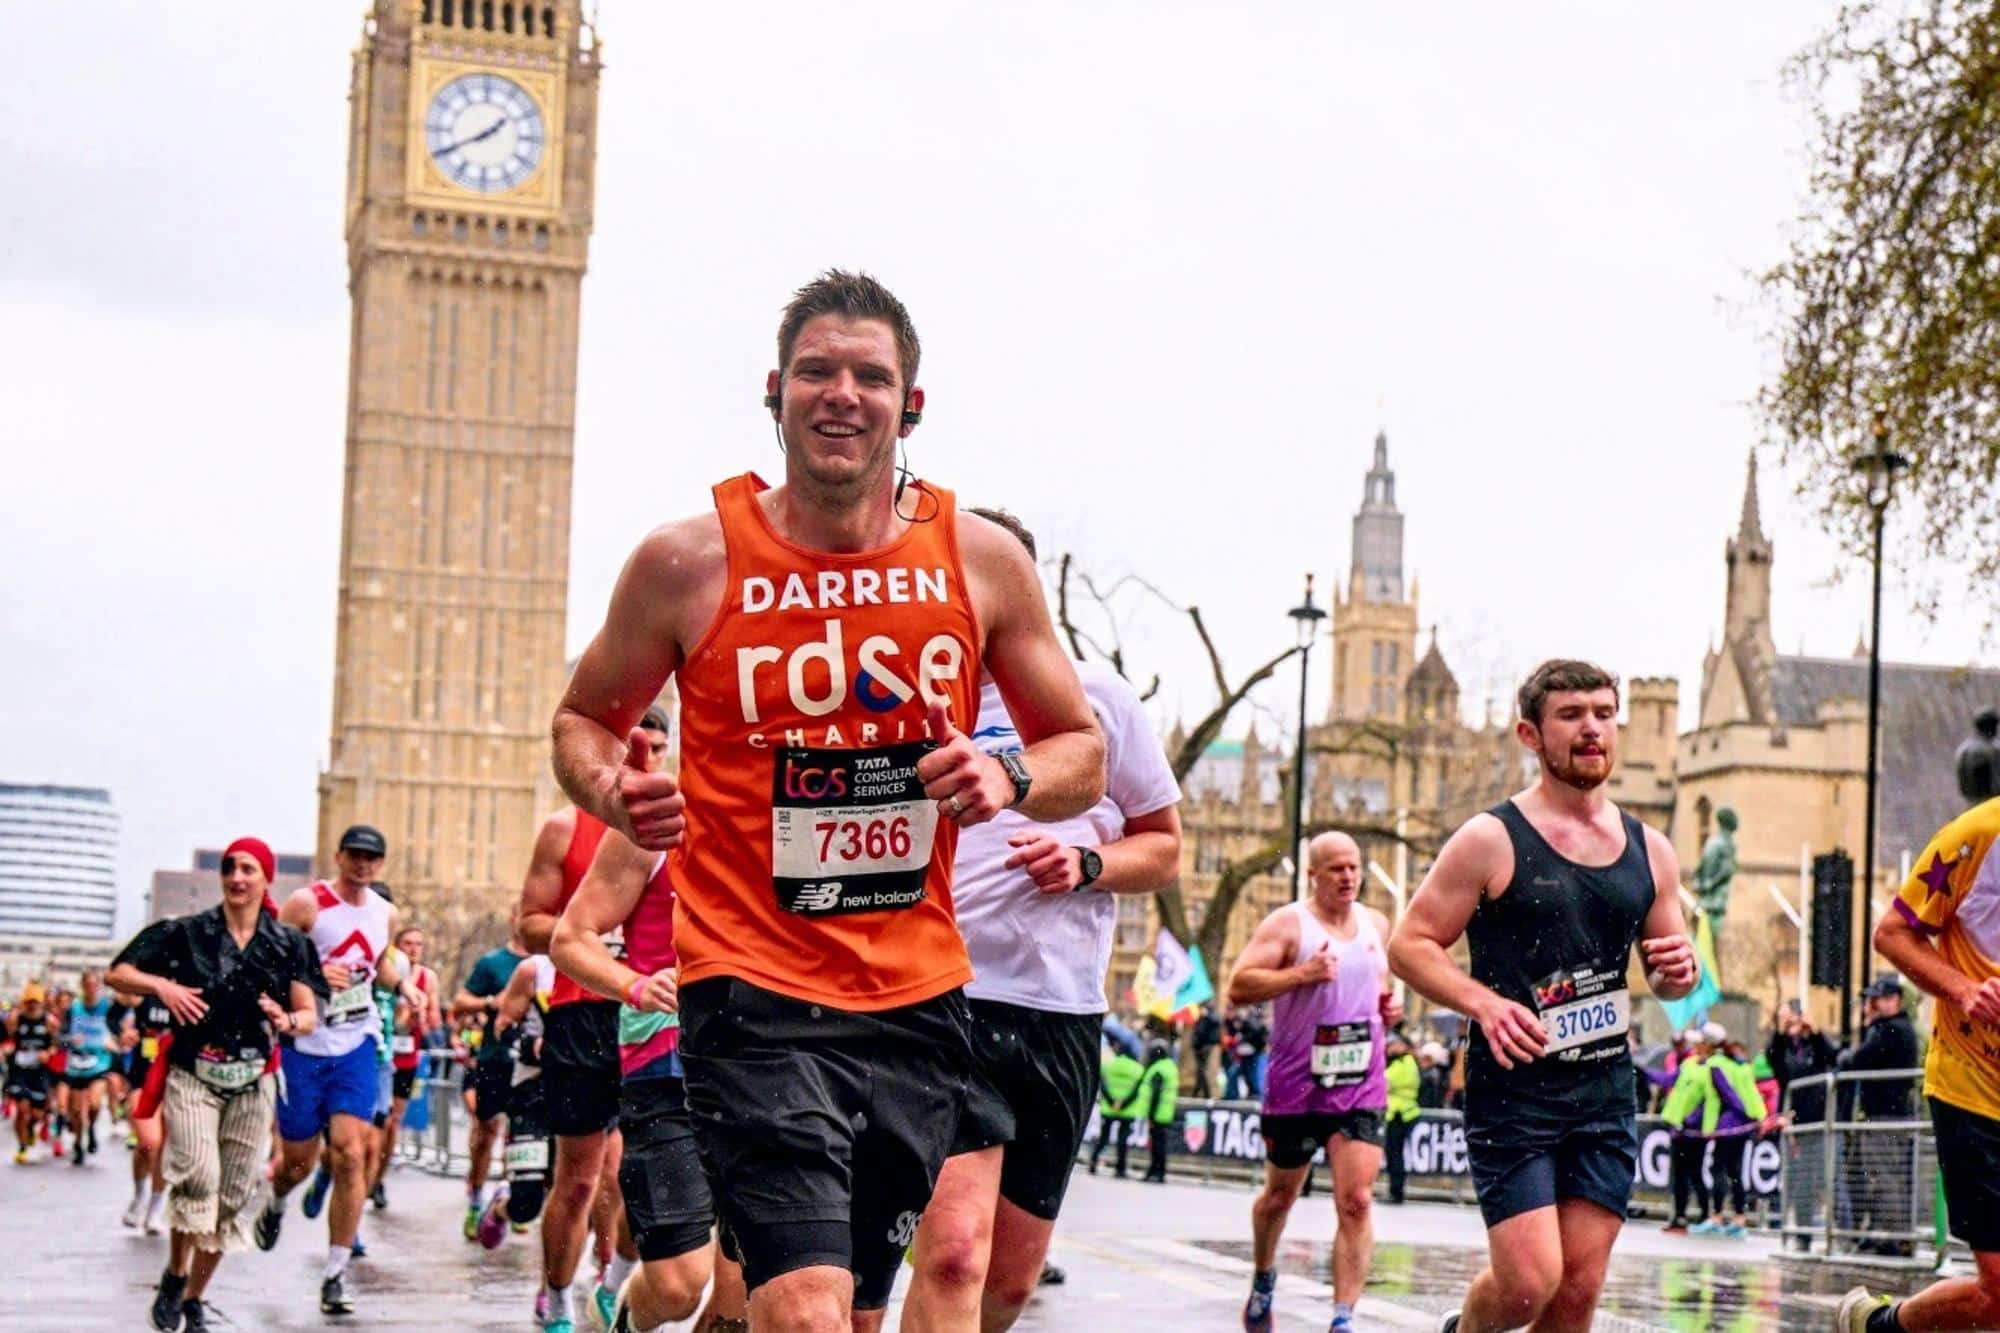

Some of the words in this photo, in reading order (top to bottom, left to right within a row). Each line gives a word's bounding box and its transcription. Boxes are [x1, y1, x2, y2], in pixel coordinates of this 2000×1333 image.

[743, 567, 949, 614] DARREN
[855, 757, 891, 770] TATA
[785, 759, 847, 799] tcs
[854, 782, 907, 798] SERVICES
[815, 816, 912, 863] 7366
[843, 893, 872, 908] new
[1556, 1001, 1617, 1039] 37026
[1320, 1048, 1364, 1067] 41047
